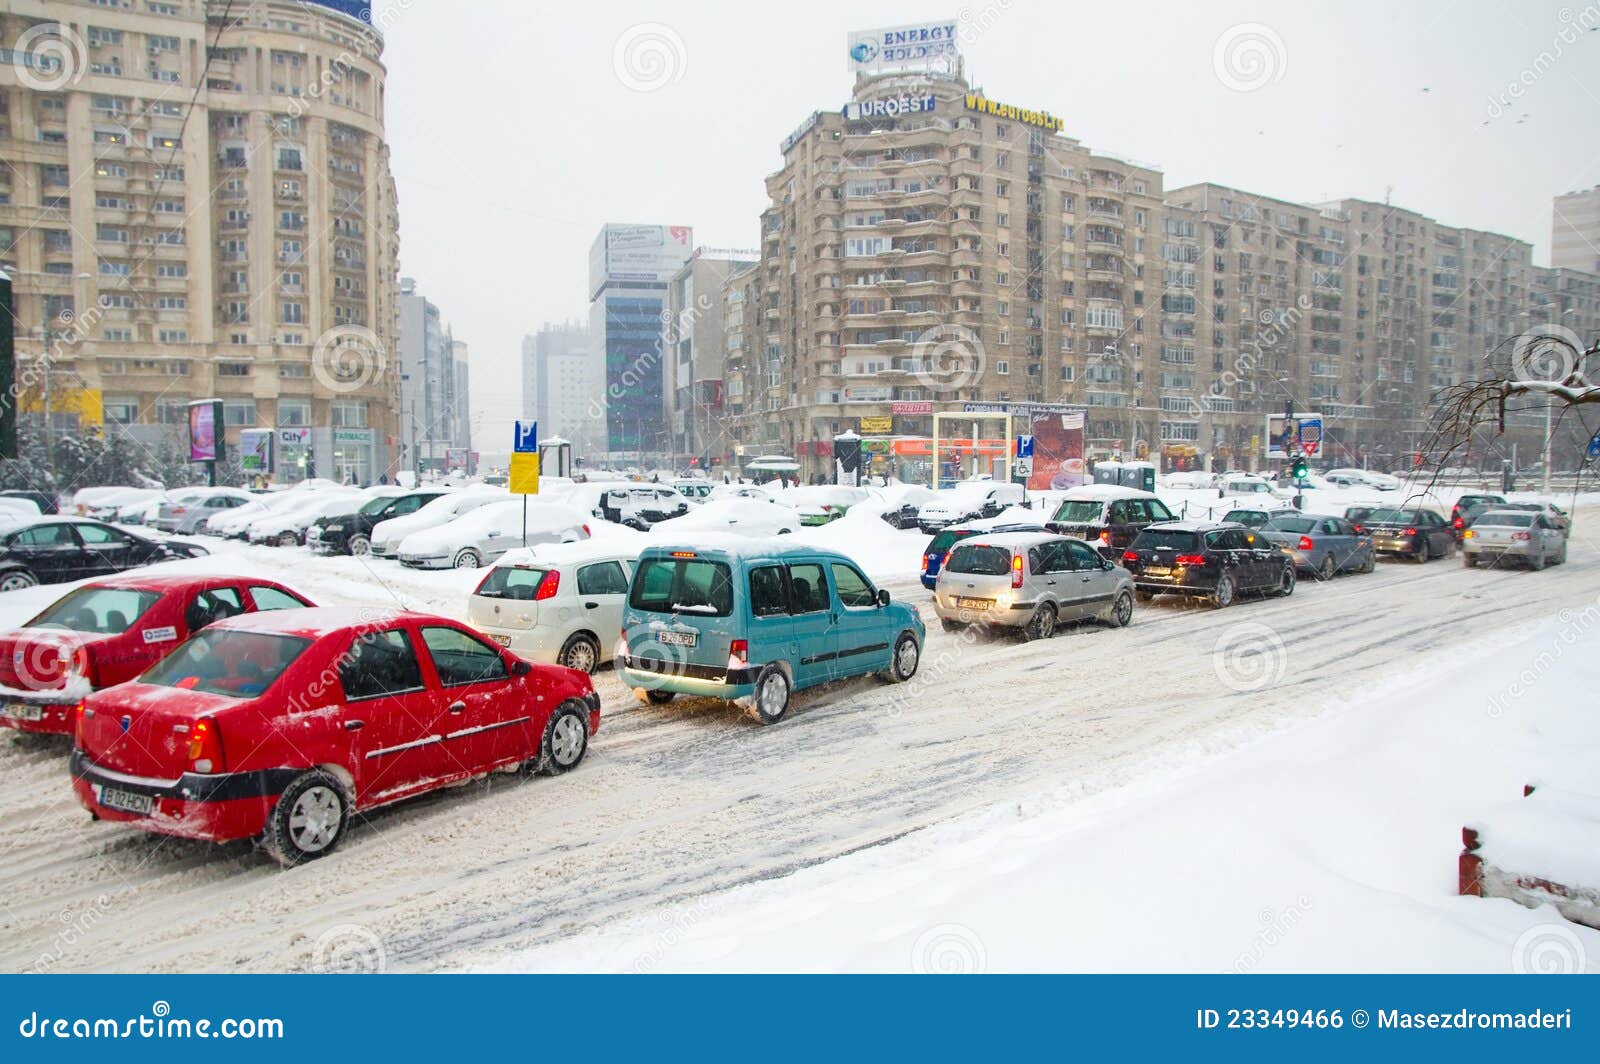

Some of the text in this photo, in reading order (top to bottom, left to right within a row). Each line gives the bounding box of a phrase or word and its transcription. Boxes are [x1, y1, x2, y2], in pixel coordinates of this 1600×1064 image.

[884, 25, 955, 45] ENERGY
[847, 96, 931, 120] UROEST
[282, 431, 302, 442] City
[106, 789, 113, 803] B
